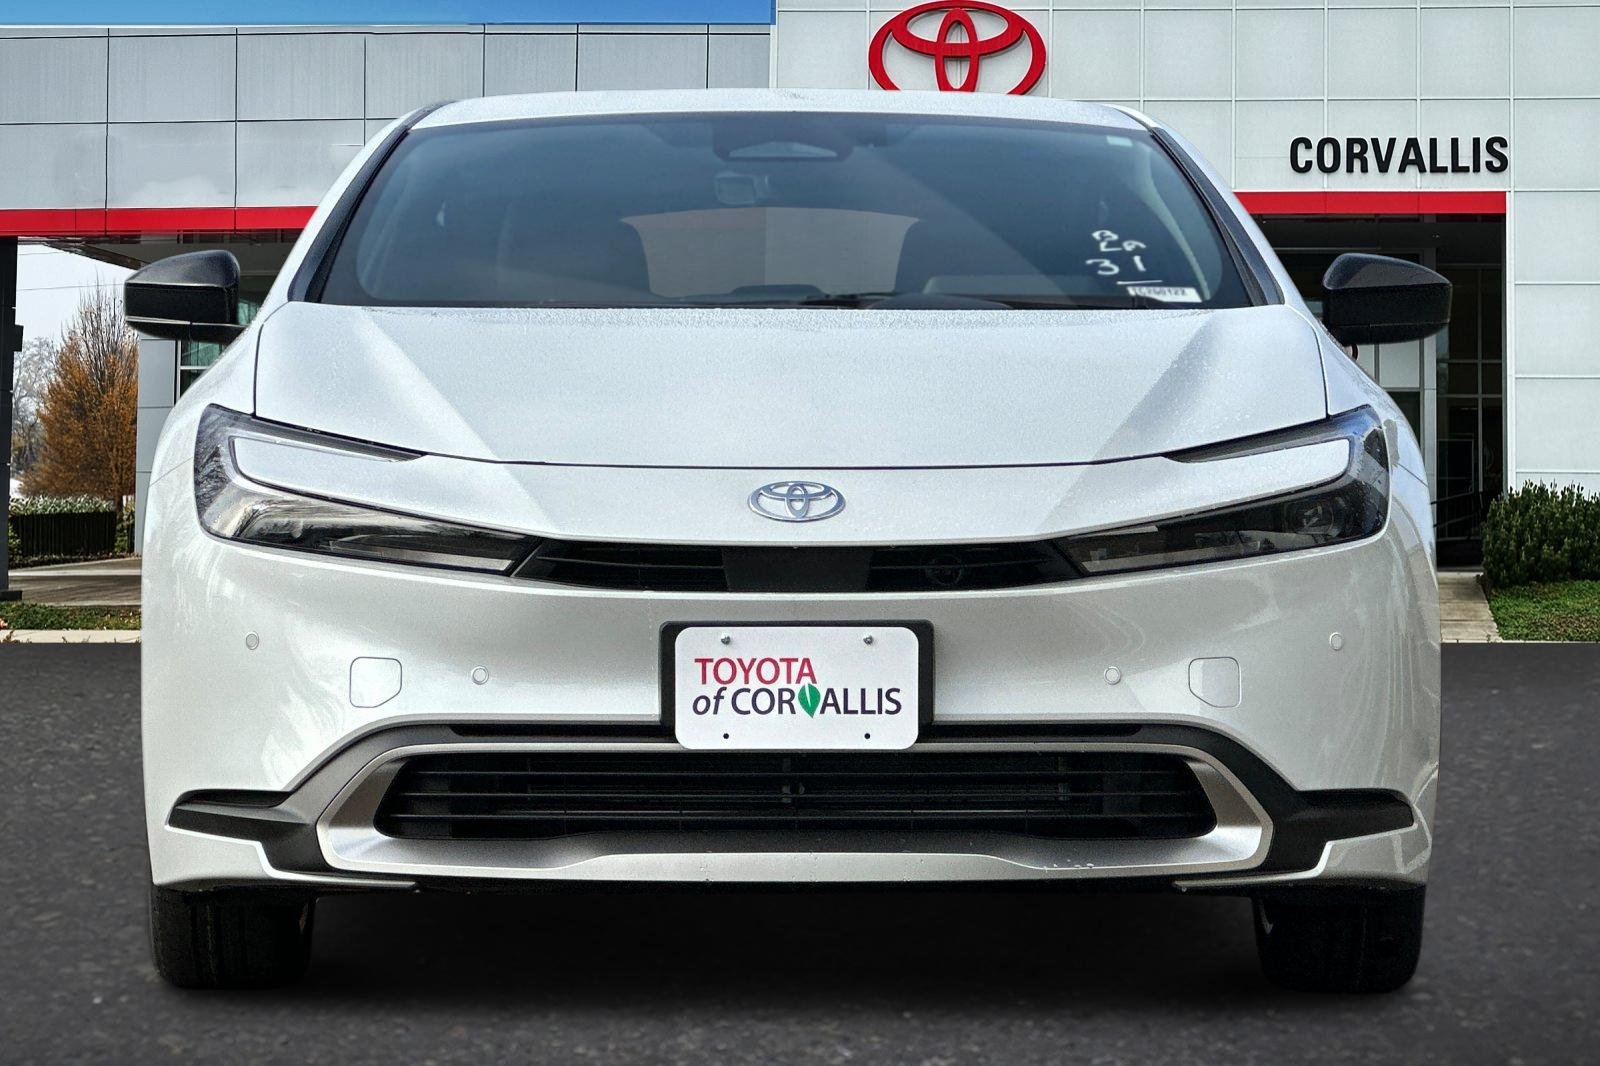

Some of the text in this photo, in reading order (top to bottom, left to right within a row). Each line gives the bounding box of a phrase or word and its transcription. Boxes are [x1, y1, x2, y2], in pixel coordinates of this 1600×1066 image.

[1290, 136, 1509, 174] CORVALLIS
[694, 657, 817, 685] TOYOTA
[692, 686, 727, 715] of
